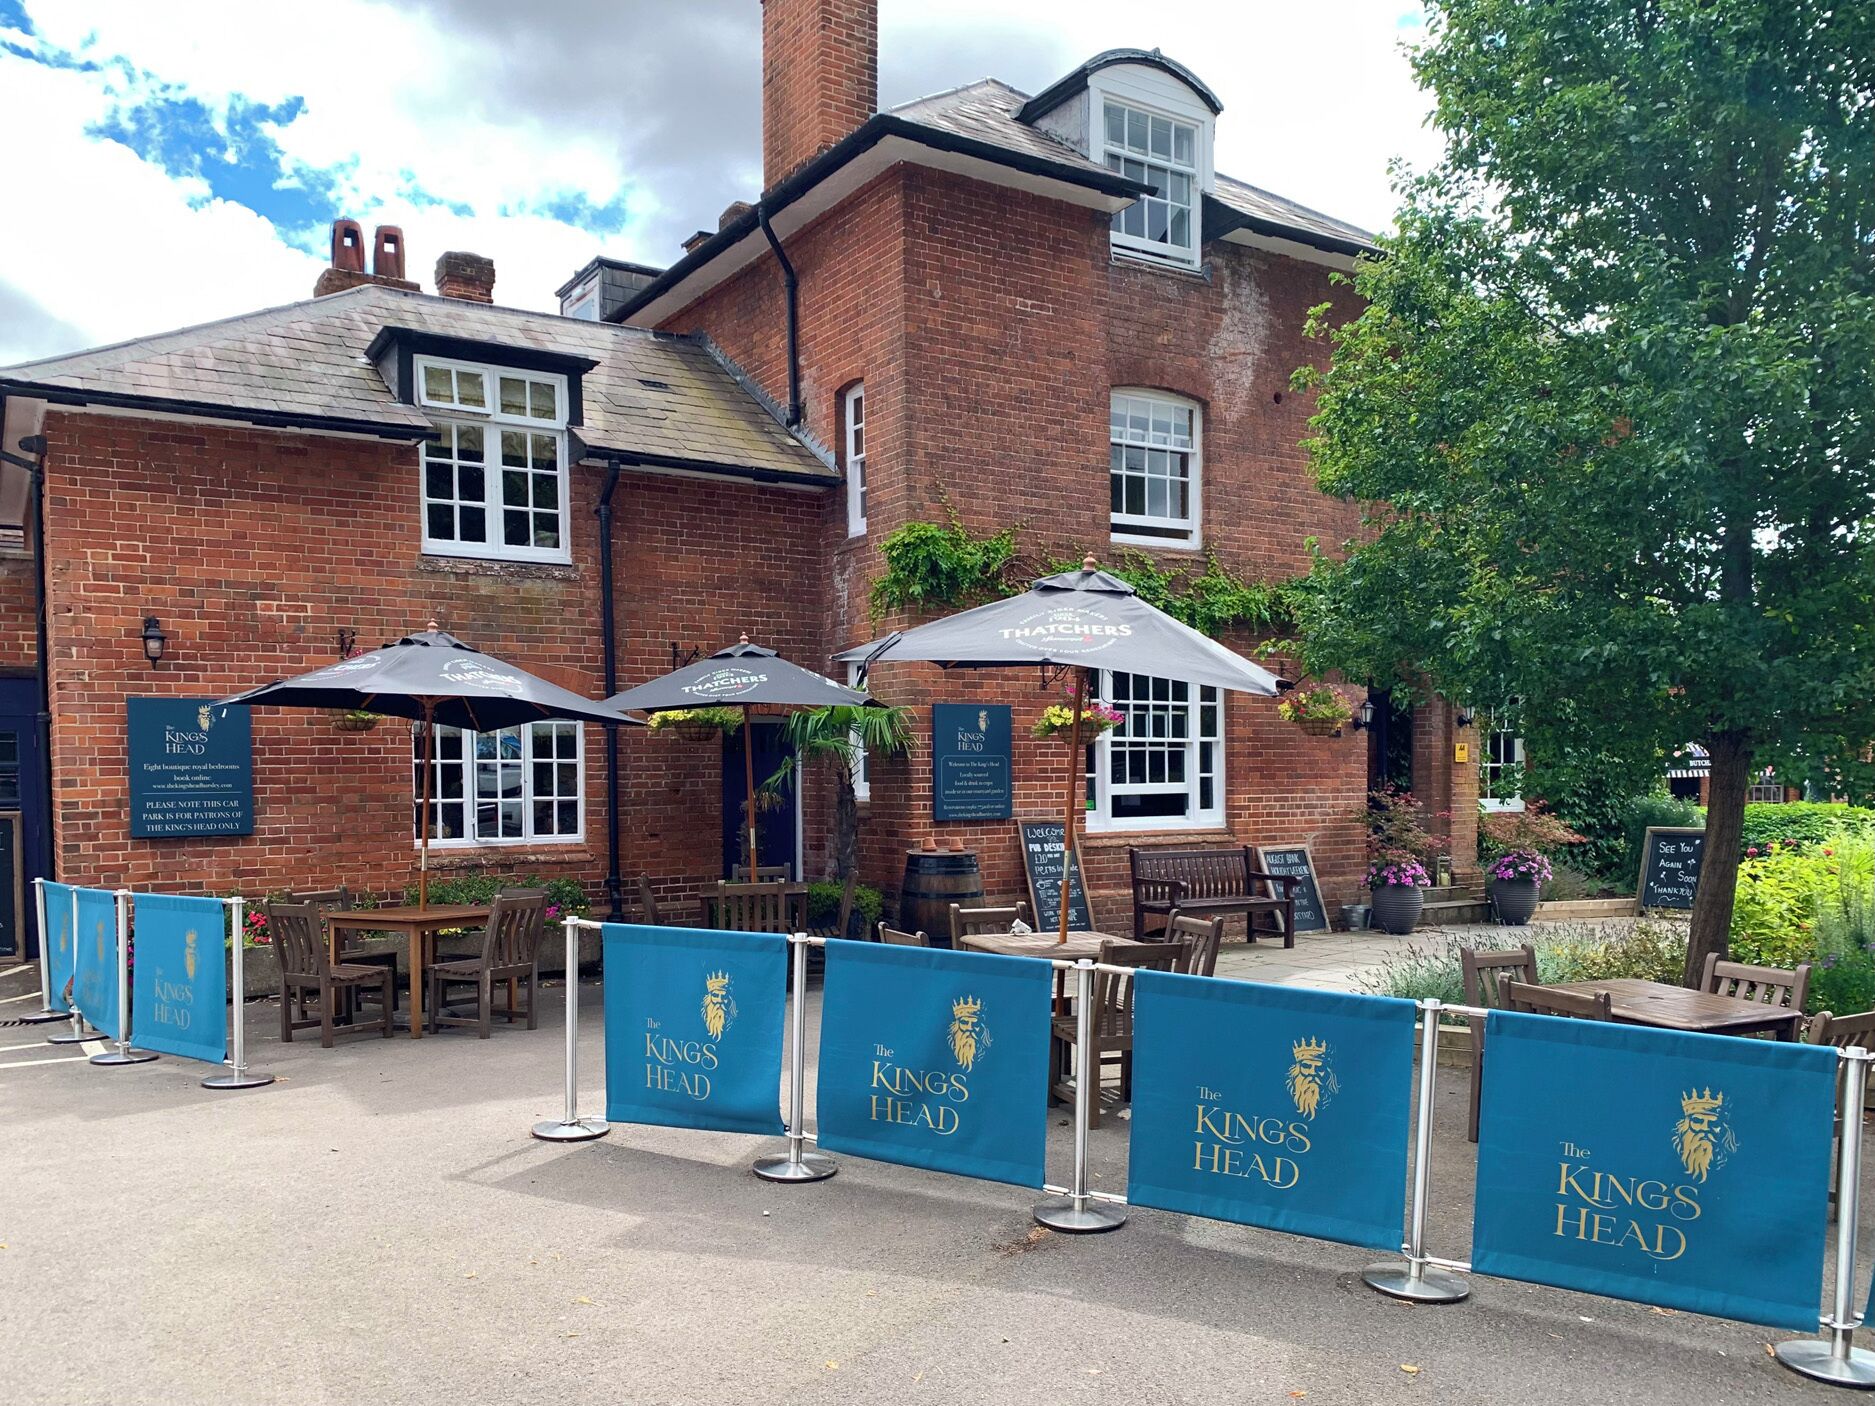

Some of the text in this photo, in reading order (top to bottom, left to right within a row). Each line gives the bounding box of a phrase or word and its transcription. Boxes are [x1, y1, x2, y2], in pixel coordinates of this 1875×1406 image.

[998, 624, 1132, 639] THATCHERS
[681, 674, 768, 693] THATCHERS
[166, 743, 205, 755] HEAD
[957, 742, 983, 752] HEAD
[143, 763, 161, 772] Eight
[162, 763, 191, 772] boutique
[192, 763, 208, 772] royal
[146, 801, 177, 809] PLEASE
[194, 811, 230, 819] PATRONS
[165, 823, 193, 832] KING'S
[1027, 828, 1064, 838] Welcome
[1028, 844, 1041, 852] PUB
[1660, 842, 1676, 853] SEE
[1266, 854, 1300, 864] AUGUST BANK
[1659, 859, 1682, 868] AGAIN
[1678, 871, 1697, 882] SOON
[1653, 884, 1678, 894] THANK
[154, 1003, 190, 1030] HEAD
[647, 1017, 661, 1029] The
[874, 1044, 894, 1057] The
[645, 1063, 711, 1101] HEAD
[1196, 1086, 1222, 1101] The
[870, 1094, 960, 1135] HEAD
[1560, 1141, 1591, 1159] The
[1193, 1141, 1299, 1189] HEAD
[1552, 1203, 1687, 1261] HEAD
